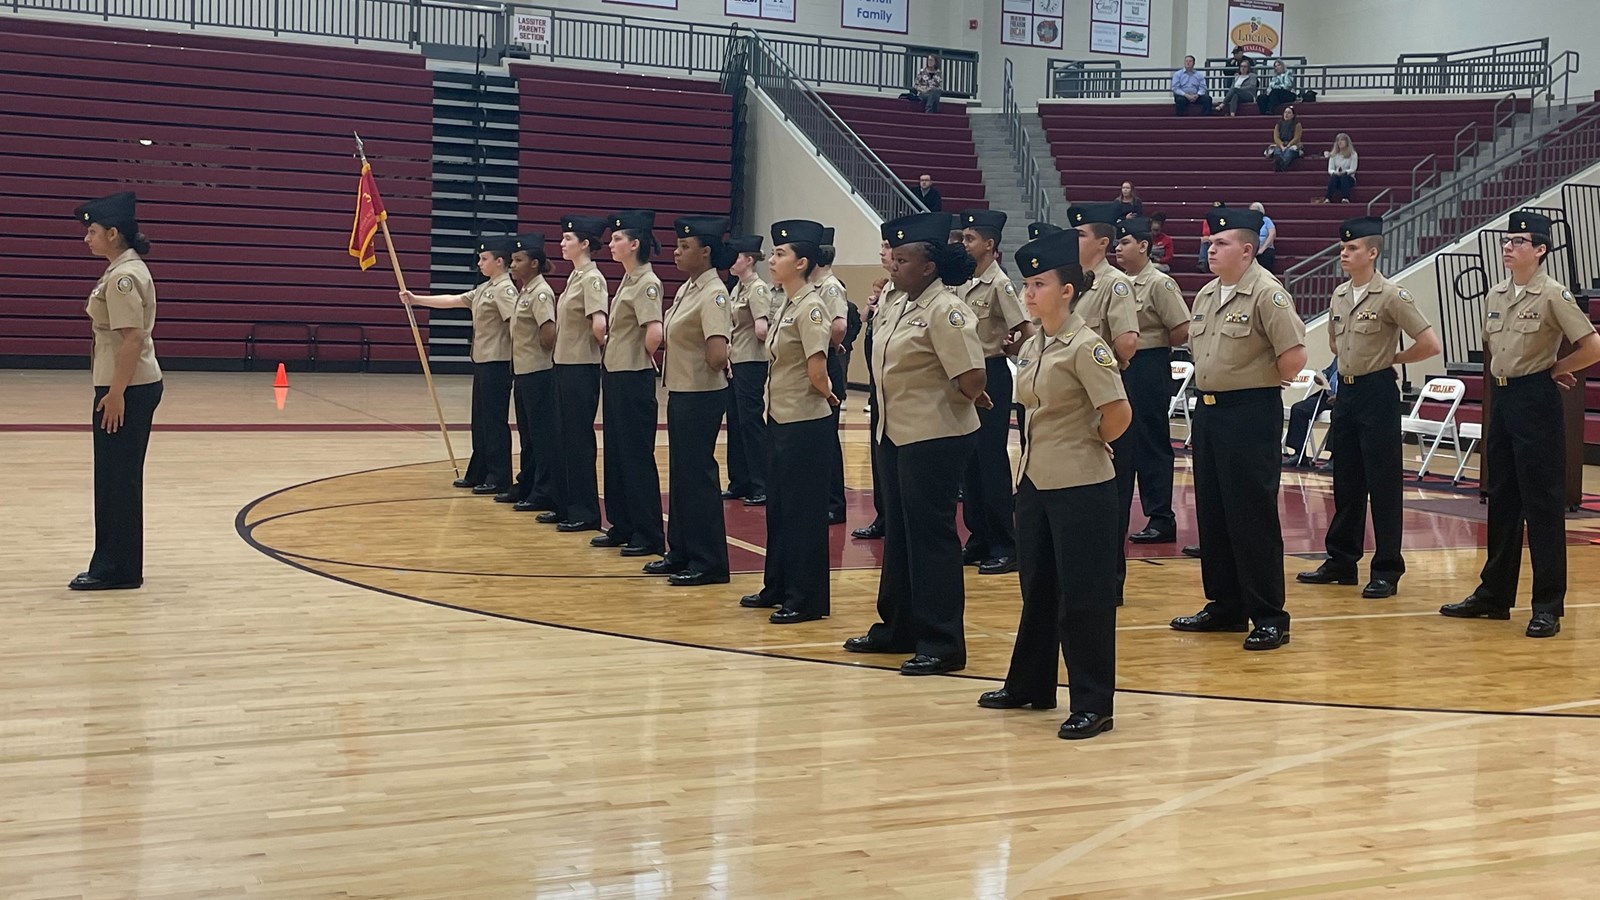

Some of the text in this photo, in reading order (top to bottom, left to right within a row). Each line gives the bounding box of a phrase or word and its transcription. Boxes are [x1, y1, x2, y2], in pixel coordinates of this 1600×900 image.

[856, 7, 892, 23] Family
[518, 17, 546, 26] LASSITER
[518, 25, 545, 34] PARENTS
[519, 33, 545, 41] SECTION
[1238, 29, 1273, 44] Lucia's
[1429, 383, 1456, 393] TROJANS
